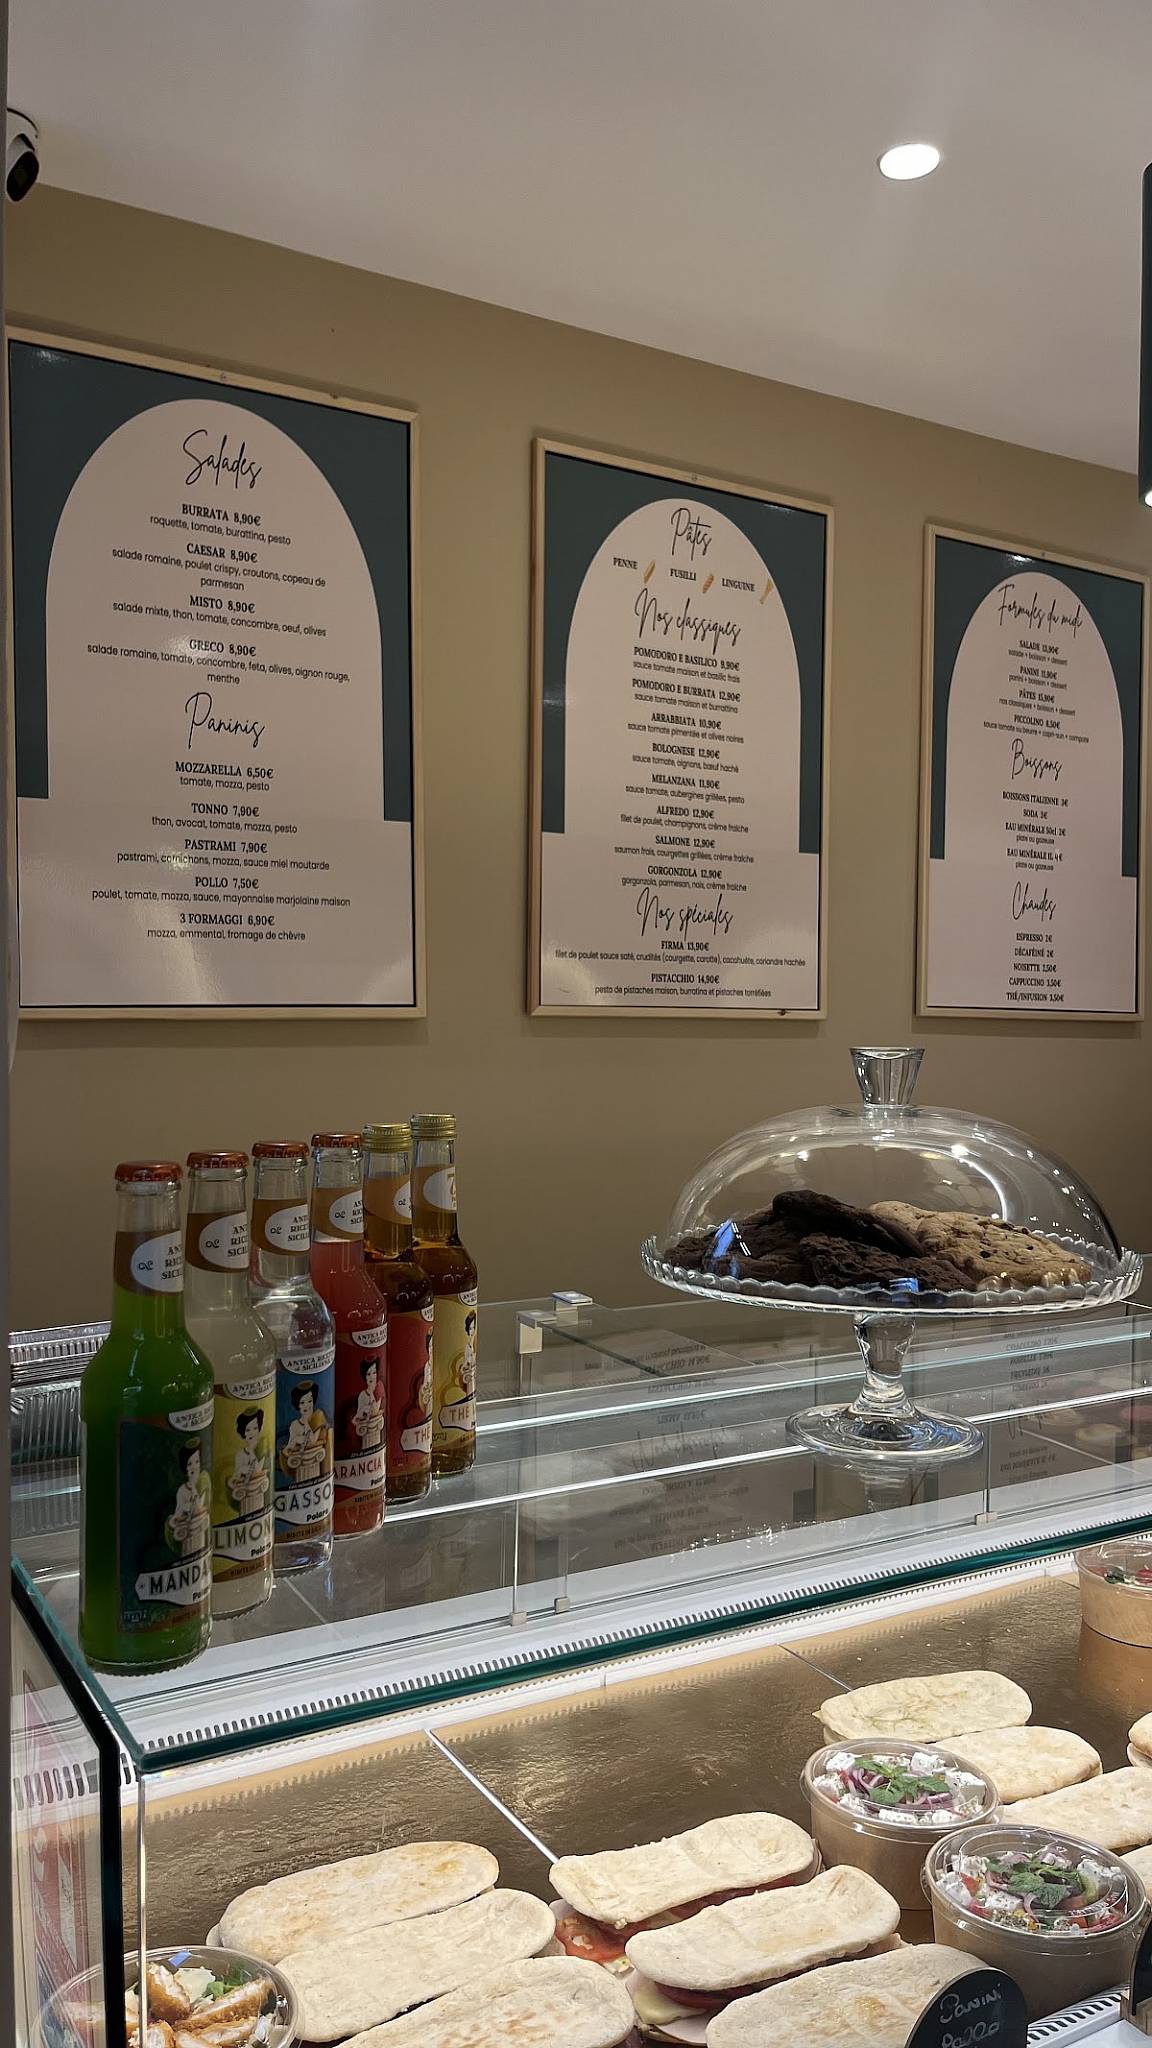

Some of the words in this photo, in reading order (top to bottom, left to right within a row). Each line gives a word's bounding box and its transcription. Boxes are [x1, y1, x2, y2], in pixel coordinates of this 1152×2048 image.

[183, 429, 262, 489] Salades
[182, 503, 229, 521] BURRATA
[233, 512, 261, 526] 8,90€
[267, 534, 291, 545] pesto
[670, 508, 712, 561] Pâtes
[186, 543, 226, 558] CAESAR
[230, 549, 258, 563] 8,90€
[112, 548, 143, 561] salade
[184, 560, 212, 571] poulet
[281, 574, 314, 585] copeau
[314, 577, 326, 587] de
[613, 557, 638, 570] PENNE
[670, 568, 697, 581] FUSILLI
[721, 578, 755, 592] LINGUINE
[200, 577, 244, 590] parmesan
[189, 595, 223, 609] MISTO
[227, 600, 255, 614] 8,90€
[112, 602, 143, 614] salade
[303, 625, 326, 637] olives
[635, 588, 673, 638] Nos
[676, 598, 741, 655] classiques
[189, 639, 224, 653] GRECO
[229, 644, 256, 657] 8,90€
[87, 644, 118, 656] salade
[295, 667, 323, 679] oignon
[633, 646, 678, 661] POMODORO
[678, 653, 683, 663] E
[684, 654, 718, 668] BASILICO
[207, 673, 240, 685] menthe
[632, 678, 676, 693] POMODORO
[676, 684, 682, 694] E
[683, 685, 716, 699] BURRATA
[184, 692, 265, 750] Paninis
[651, 713, 696, 726] ARRABBIATA
[652, 742, 695, 756] BOLOGNESE
[1011, 738, 1062, 780] Boissons
[175, 761, 242, 776] MOZZARELLA
[246, 767, 274, 779] 6,50€
[246, 782, 270, 792] pesto
[652, 774, 696, 787] MELANZANA
[191, 802, 228, 815] TONNO
[232, 805, 260, 817] 7,90€
[656, 805, 690, 817] ALFREDO
[1023, 808, 1039, 818] SODA
[274, 824, 298, 834] pesto
[184, 839, 236, 852] PASTRAMI
[240, 842, 268, 854] 7,90€
[655, 835, 691, 847] SALMONE
[243, 858, 269, 867] sauce
[270, 859, 288, 868] miel
[289, 861, 330, 870] moutarde
[647, 865, 698, 877] GORGONZOLA
[195, 876, 228, 888] POLLO
[232, 877, 259, 890] 7,50€
[223, 894, 275, 905] mayonnaise
[276, 896, 320, 907] marjolaine
[320, 897, 351, 906] maison
[1012, 881, 1057, 922] Chaudes
[179, 912, 186, 923] 3
[188, 913, 243, 925] FORMAGGI
[247, 915, 275, 926] 6,90€
[636, 886, 674, 936] Nos
[679, 893, 734, 942] spéciales
[227, 929, 264, 942] fromage
[265, 930, 277, 940] de
[277, 930, 306, 940] chèvre
[1016, 932, 1044, 942] ESPRESSO
[661, 940, 684, 950] FIRMA
[651, 973, 695, 983] PISTACCHIO
